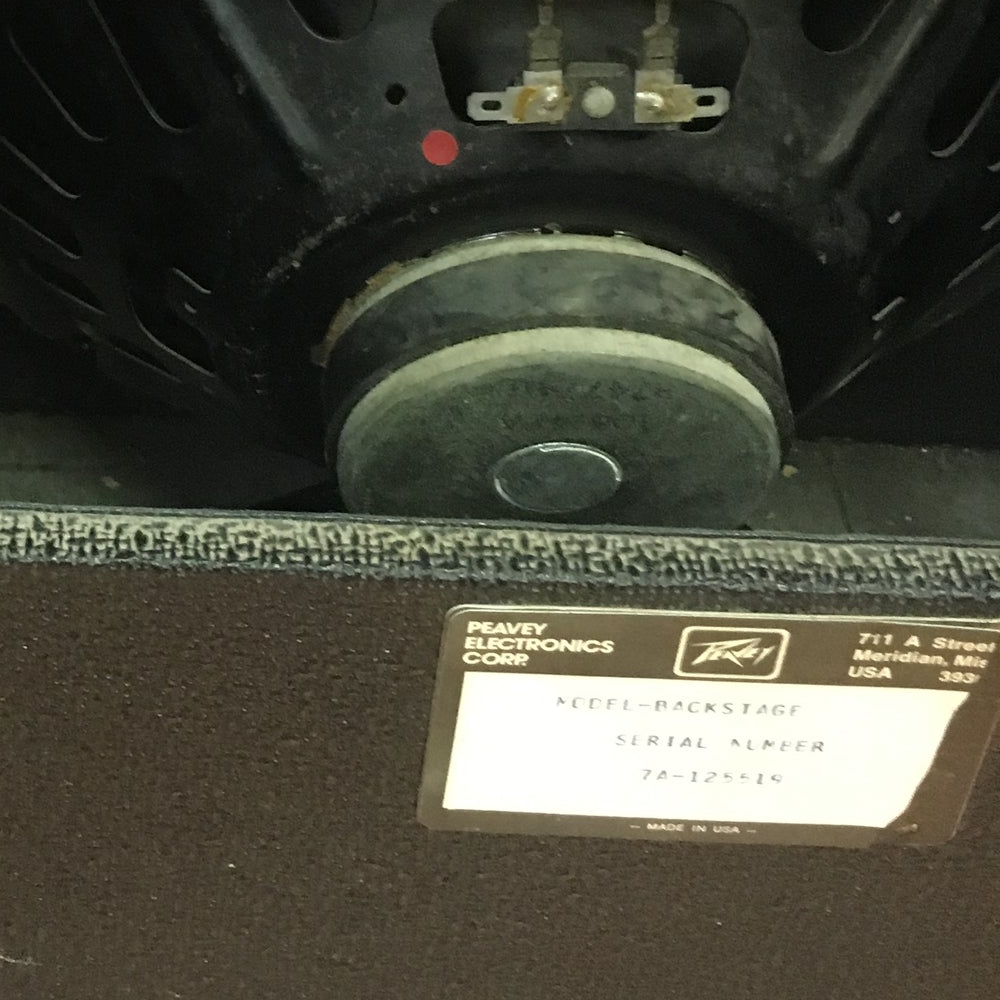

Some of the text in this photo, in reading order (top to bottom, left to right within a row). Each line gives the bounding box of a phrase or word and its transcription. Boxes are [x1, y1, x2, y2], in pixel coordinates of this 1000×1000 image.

[466, 621, 548, 636] PEAVEY
[464, 637, 615, 654] ELECTRONICS
[858, 632, 997, 653] 711 A Street
[462, 653, 529, 667] CORP.
[852, 648, 948, 667] Meridian,
[847, 665, 893, 680] USA
[615, 733, 707, 749] SERIAL
[646, 822, 741, 834] MADE IN USA
